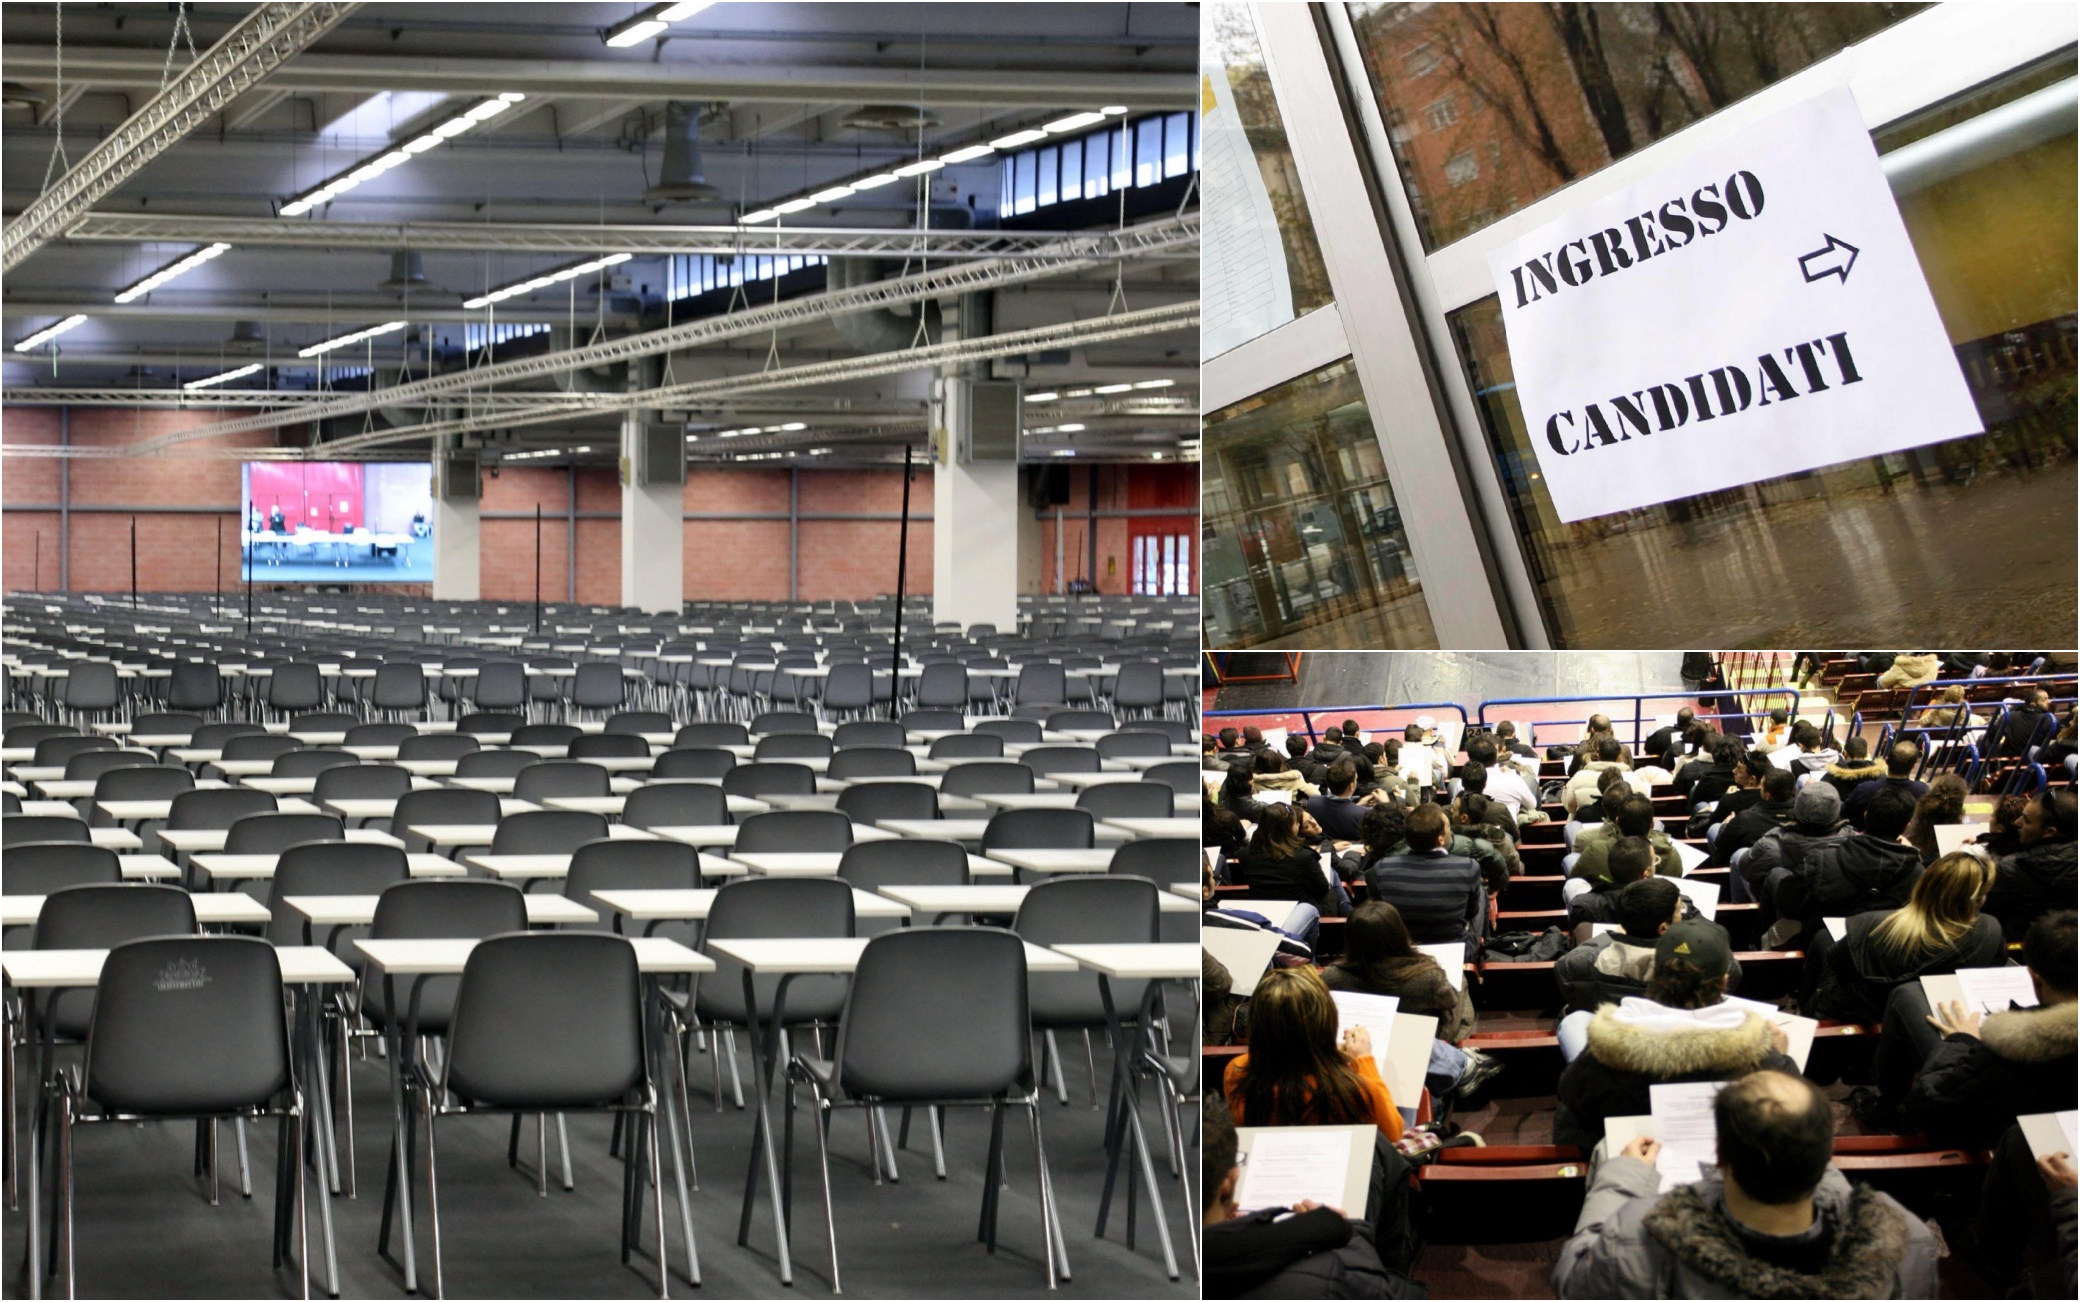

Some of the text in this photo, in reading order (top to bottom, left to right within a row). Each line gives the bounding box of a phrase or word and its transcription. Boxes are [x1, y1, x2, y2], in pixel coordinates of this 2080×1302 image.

[1510, 170, 1765, 308] INGRESSO
[1546, 332, 1863, 455] CANDIDATI
[1467, 728, 1482, 738] 24
